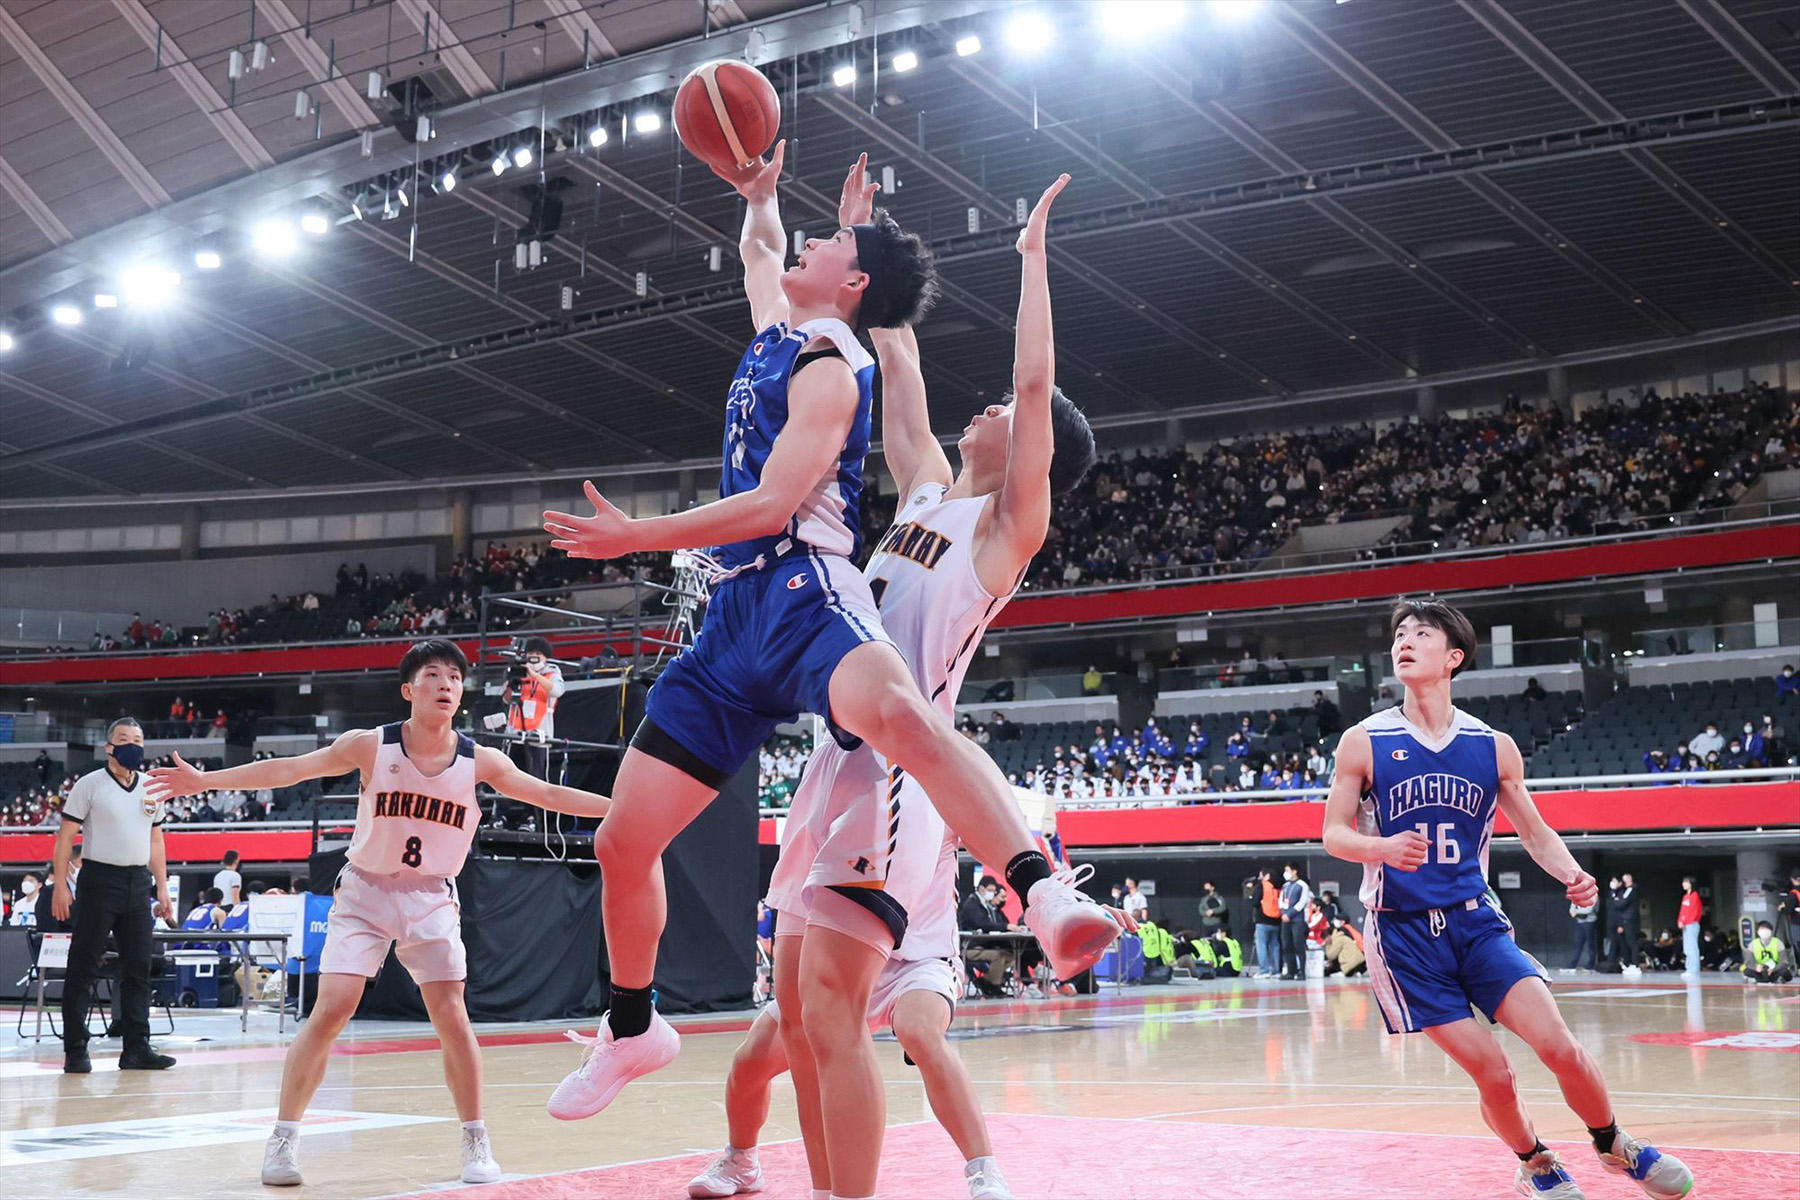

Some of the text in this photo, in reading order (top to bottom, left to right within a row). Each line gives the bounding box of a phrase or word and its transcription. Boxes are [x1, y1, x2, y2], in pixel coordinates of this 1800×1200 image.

[374, 791, 468, 831] RAKUNAN
[1389, 773, 1484, 821] HAGURO
[402, 836, 422, 868] 8
[1415, 823, 1461, 864] 16
